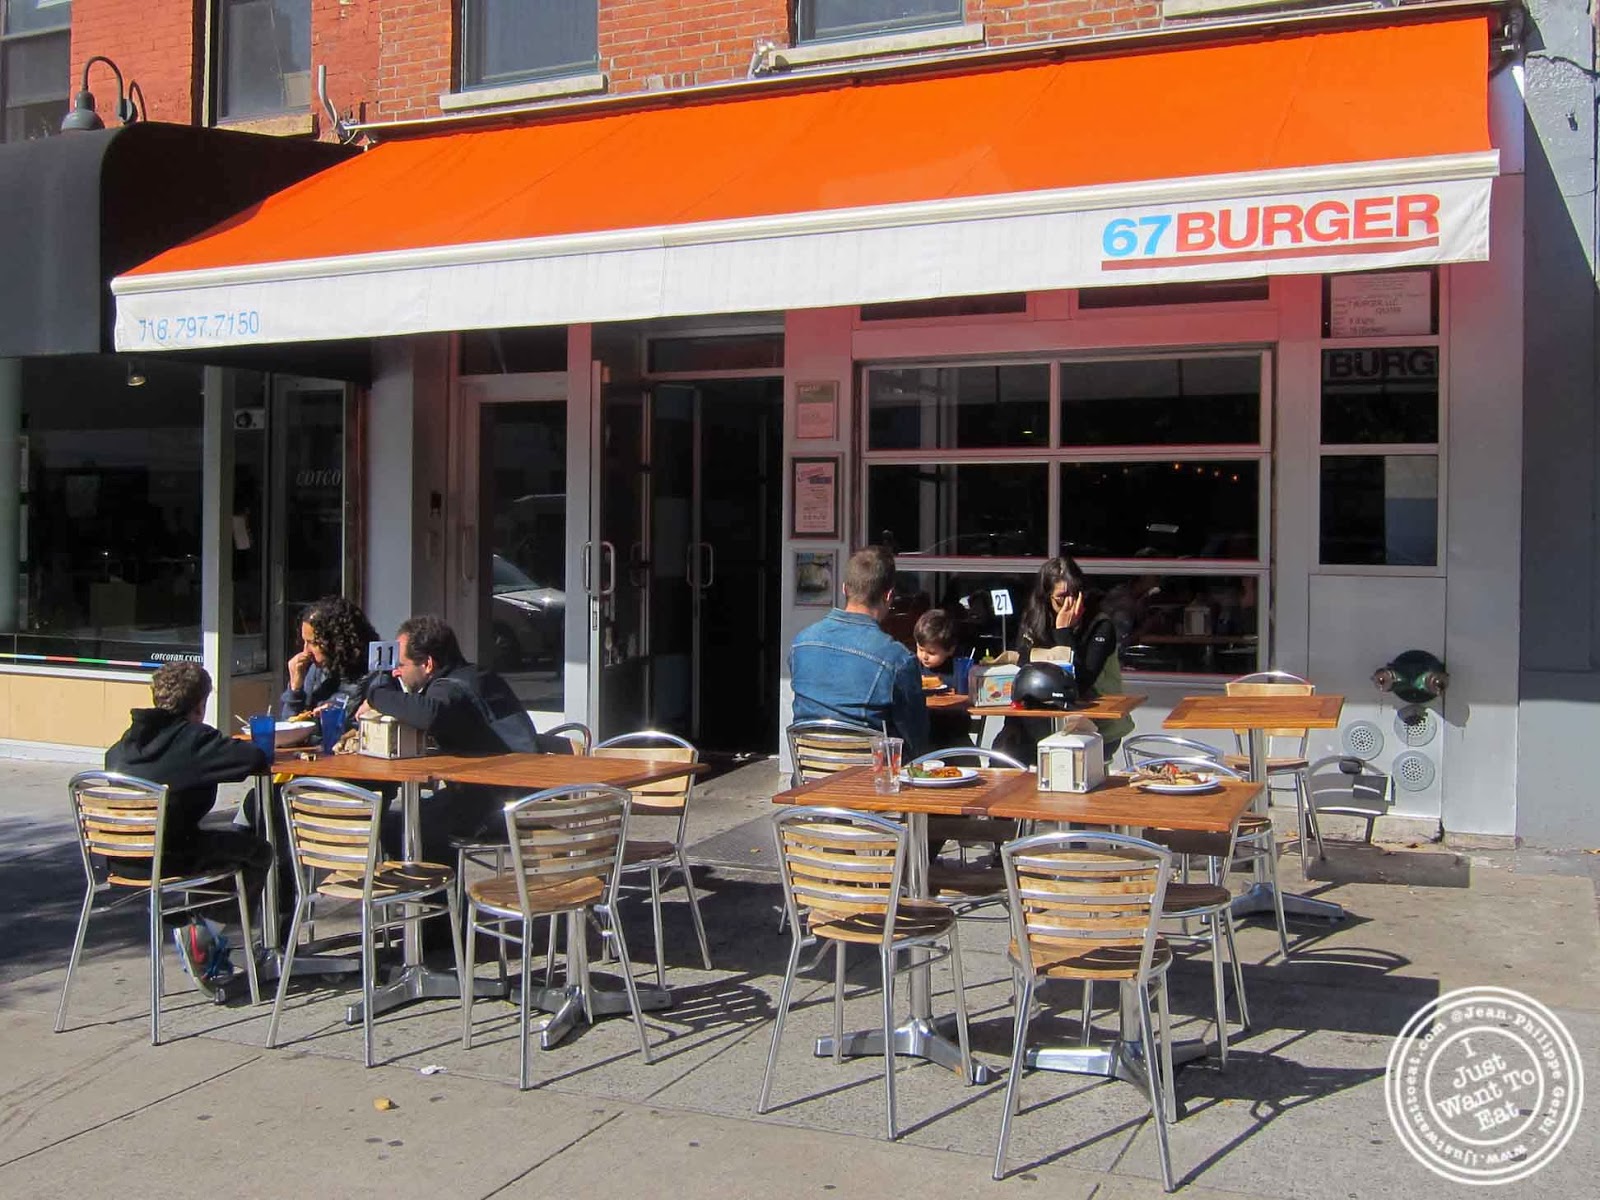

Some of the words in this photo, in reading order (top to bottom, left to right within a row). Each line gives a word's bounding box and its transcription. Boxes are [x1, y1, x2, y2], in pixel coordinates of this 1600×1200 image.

[139, 311, 260, 341] 718.797.7150
[995, 594, 1007, 611] 27
[150, 652, 204, 663] corcoran.com
[376, 646, 393, 665] 11
